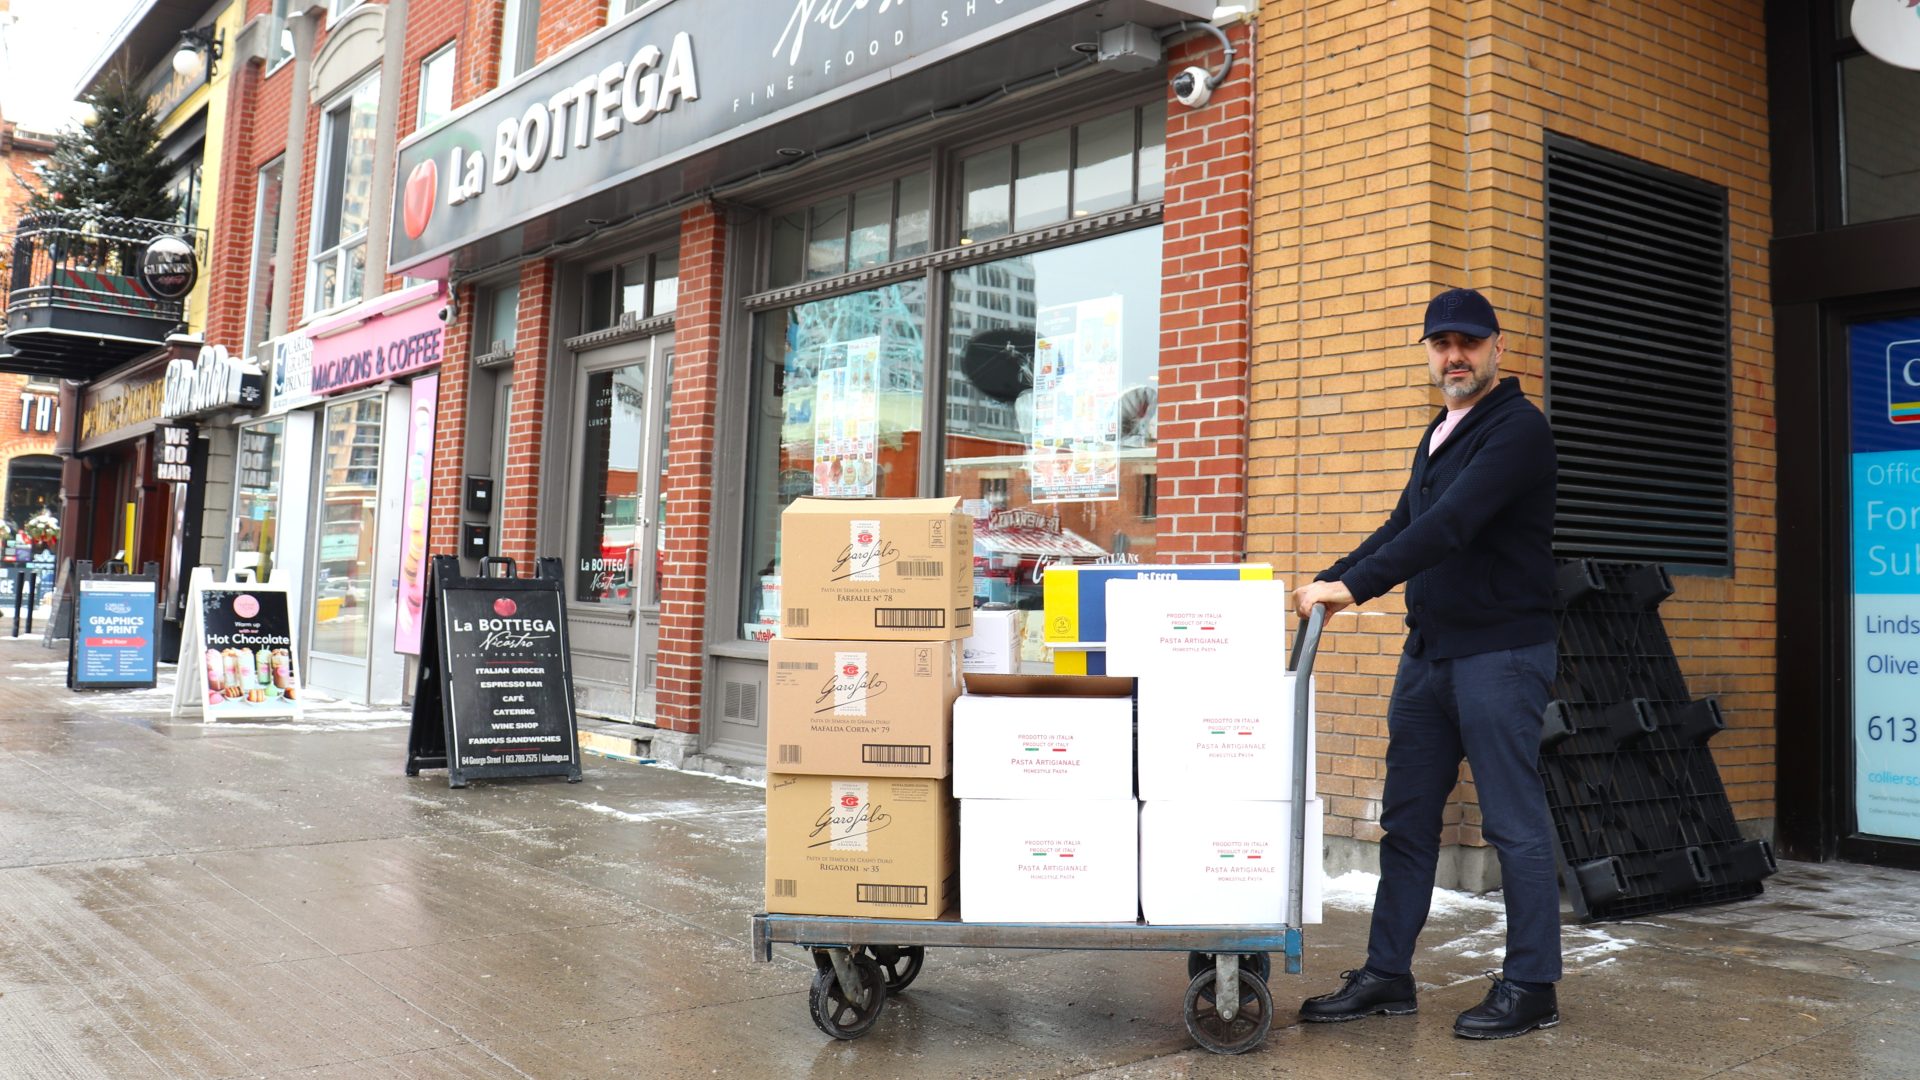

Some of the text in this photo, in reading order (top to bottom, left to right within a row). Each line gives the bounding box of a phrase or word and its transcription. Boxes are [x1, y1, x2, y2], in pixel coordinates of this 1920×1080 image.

[733, 75, 795, 113] FINE
[824, 30, 904, 75] FOOD
[941, 0, 1002, 27] SH
[447, 146, 485, 206] La
[492, 31, 699, 186] BOTTEGA
[311, 328, 442, 393] MACARONS & COFFEE
[164, 427, 190, 446] WE
[163, 446, 188, 464] DO
[157, 464, 191, 481] HAIR
[581, 558, 590, 571] La
[831, 540, 900, 580] Garofalo
[89, 616, 144, 625] GRAPHICS
[453, 618, 556, 632] La BOTTEGA
[1866, 614, 1920, 634] Linds
[95, 625, 138, 634] & PRINT
[207, 633, 290, 645] Hot Chocolate
[479, 631, 550, 650] Nicastro
[1867, 655, 1919, 675] Olive
[502, 694, 524, 702] CAFÉ
[815, 671, 888, 711] Garofalo
[493, 708, 535, 716] CATERING
[491, 722, 515, 730] WINE
[845, 725, 870, 733] CORTA
[1868, 715, 1917, 743] 613
[468, 735, 561, 745] FAMOUS SANDWICHES
[461, 756, 468, 765] 64
[1011, 758, 1080, 766] PASTA ARTIGIANALE
[1868, 771, 1920, 786] colliersc
[809, 803, 892, 846] Garofalo
[820, 864, 859, 872] RIGATONI
